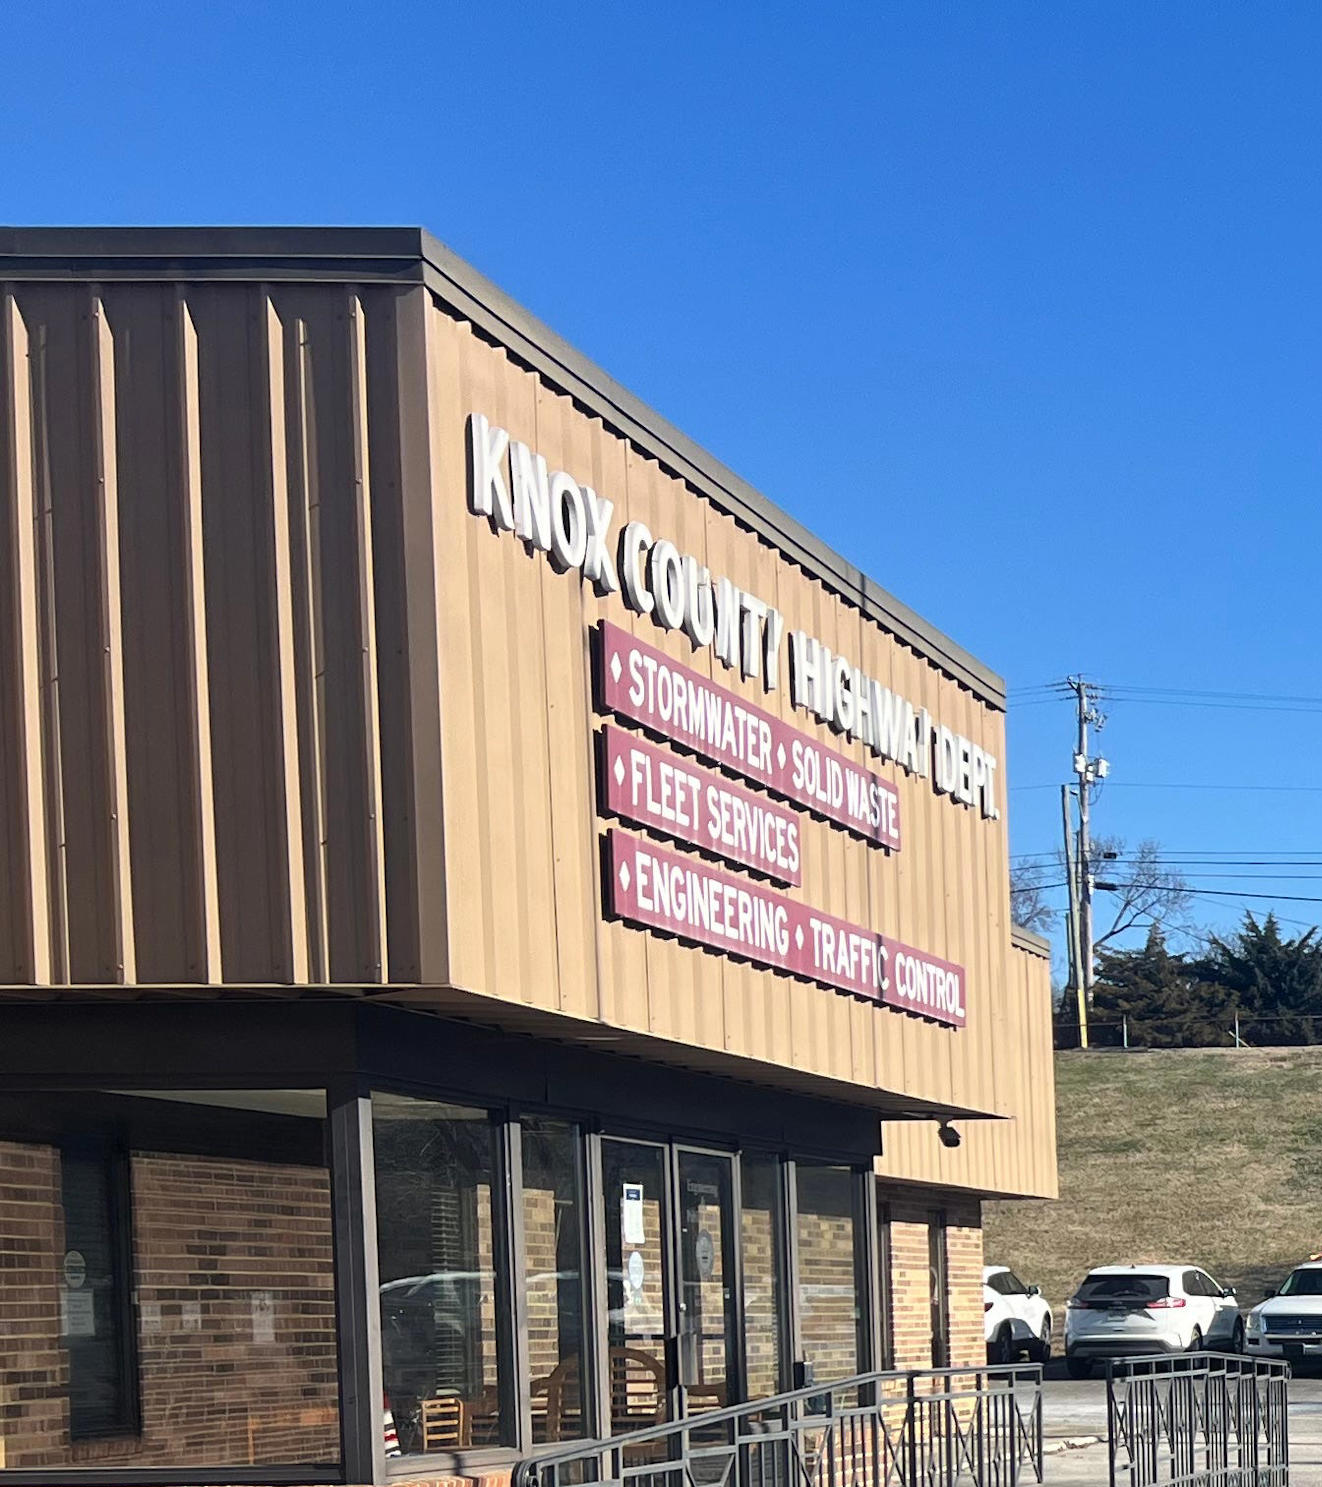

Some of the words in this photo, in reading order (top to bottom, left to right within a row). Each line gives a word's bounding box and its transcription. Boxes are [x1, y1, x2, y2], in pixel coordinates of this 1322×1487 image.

[470, 412, 617, 592] KNOX
[621, 520, 784, 690] COUNTY
[792, 630, 932, 779] HIGHWAY
[935, 725, 1000, 820] DEPT.
[628, 648, 773, 775] STORMWATER
[791, 739, 842, 809] SOLID
[845, 767, 899, 840] WASTE
[630, 749, 701, 831] FLEET
[706, 785, 800, 873] SERVICES
[634, 850, 790, 956] ENGINEERING
[809, 917, 890, 991] TRAFFIC
[895, 951, 965, 1018] CONTROL
